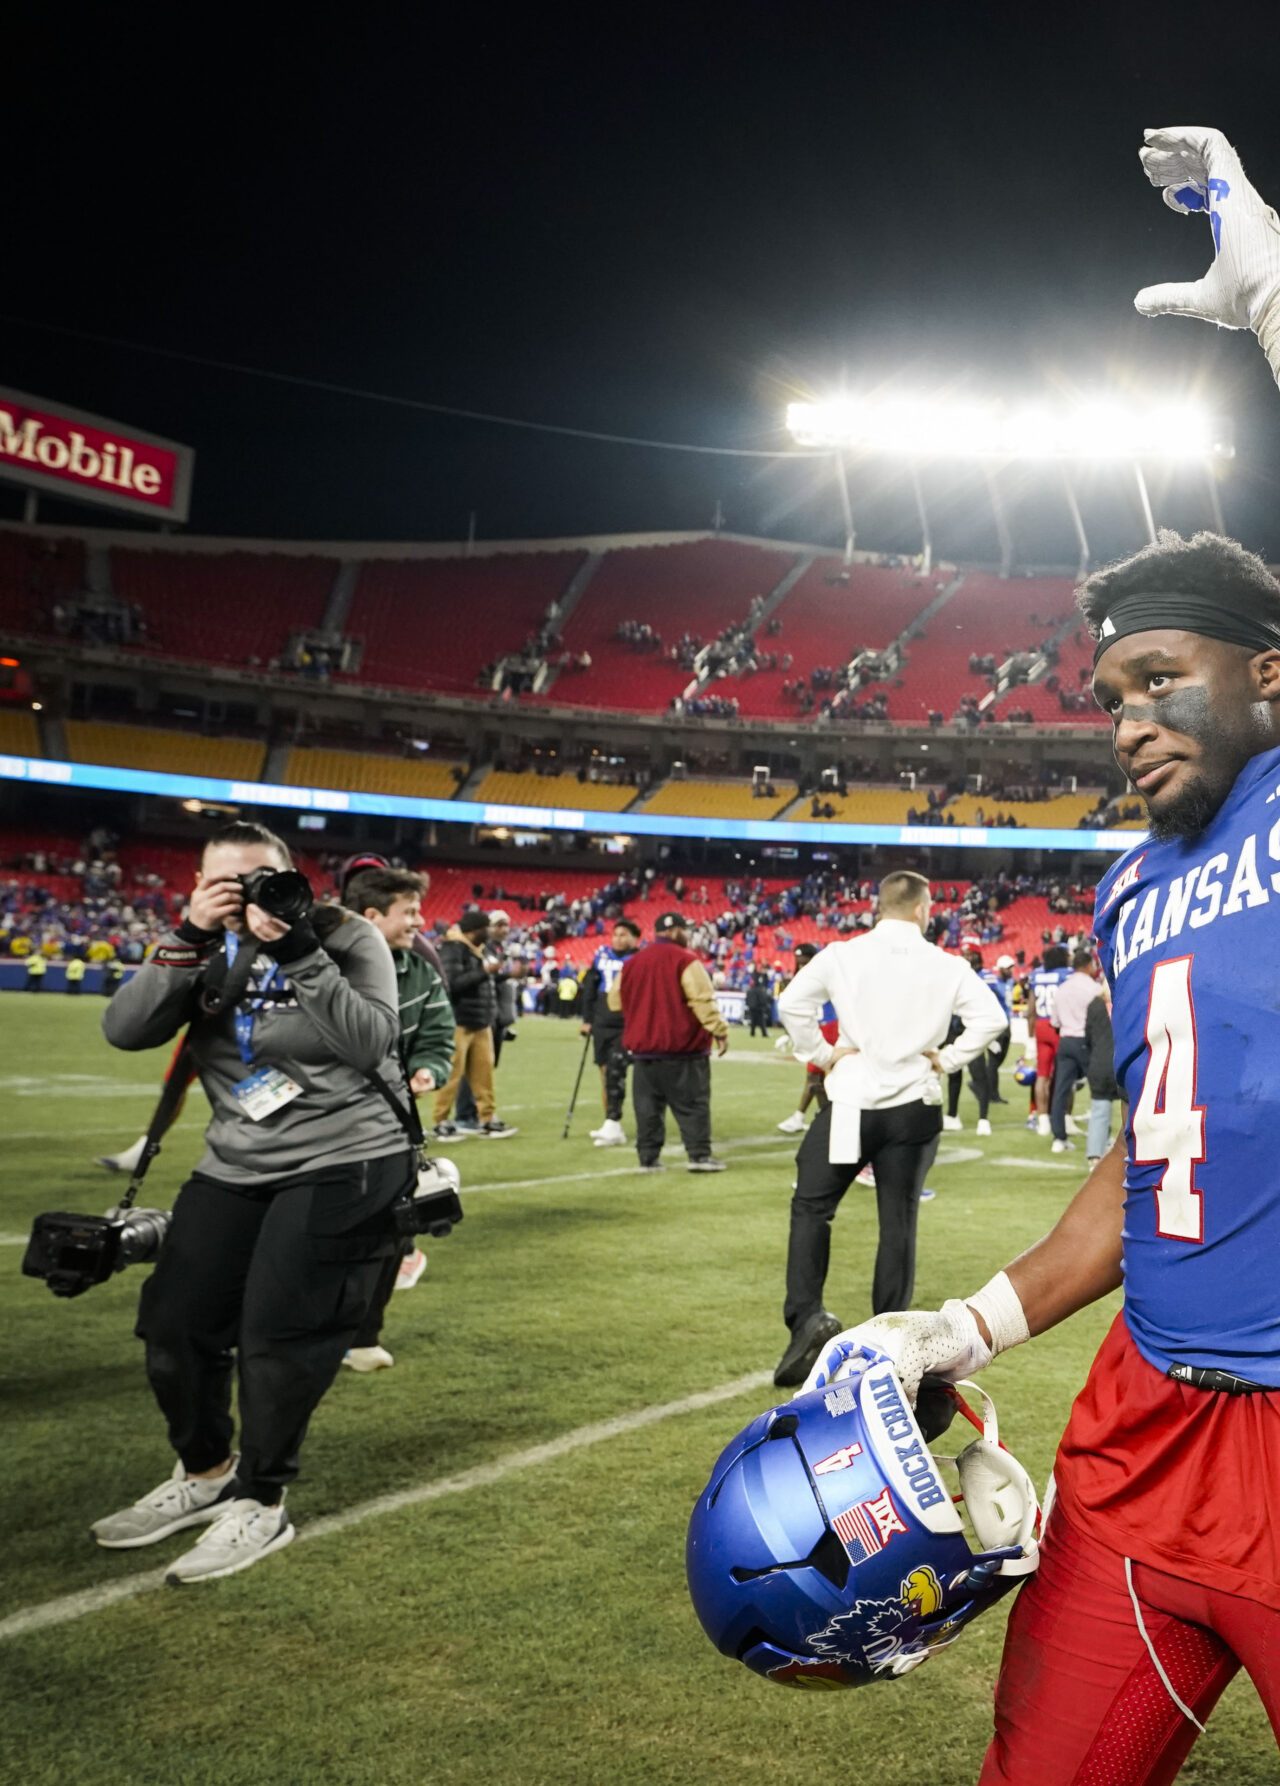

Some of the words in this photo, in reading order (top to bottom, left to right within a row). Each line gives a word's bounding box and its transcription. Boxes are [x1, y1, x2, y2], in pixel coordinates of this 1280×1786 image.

[0, 409, 162, 494] Mobile
[1131, 953, 1208, 1244] 4
[868, 1372, 914, 1442] CHALK
[812, 1441, 864, 1477] 4
[894, 1438, 946, 1511] ROCK
